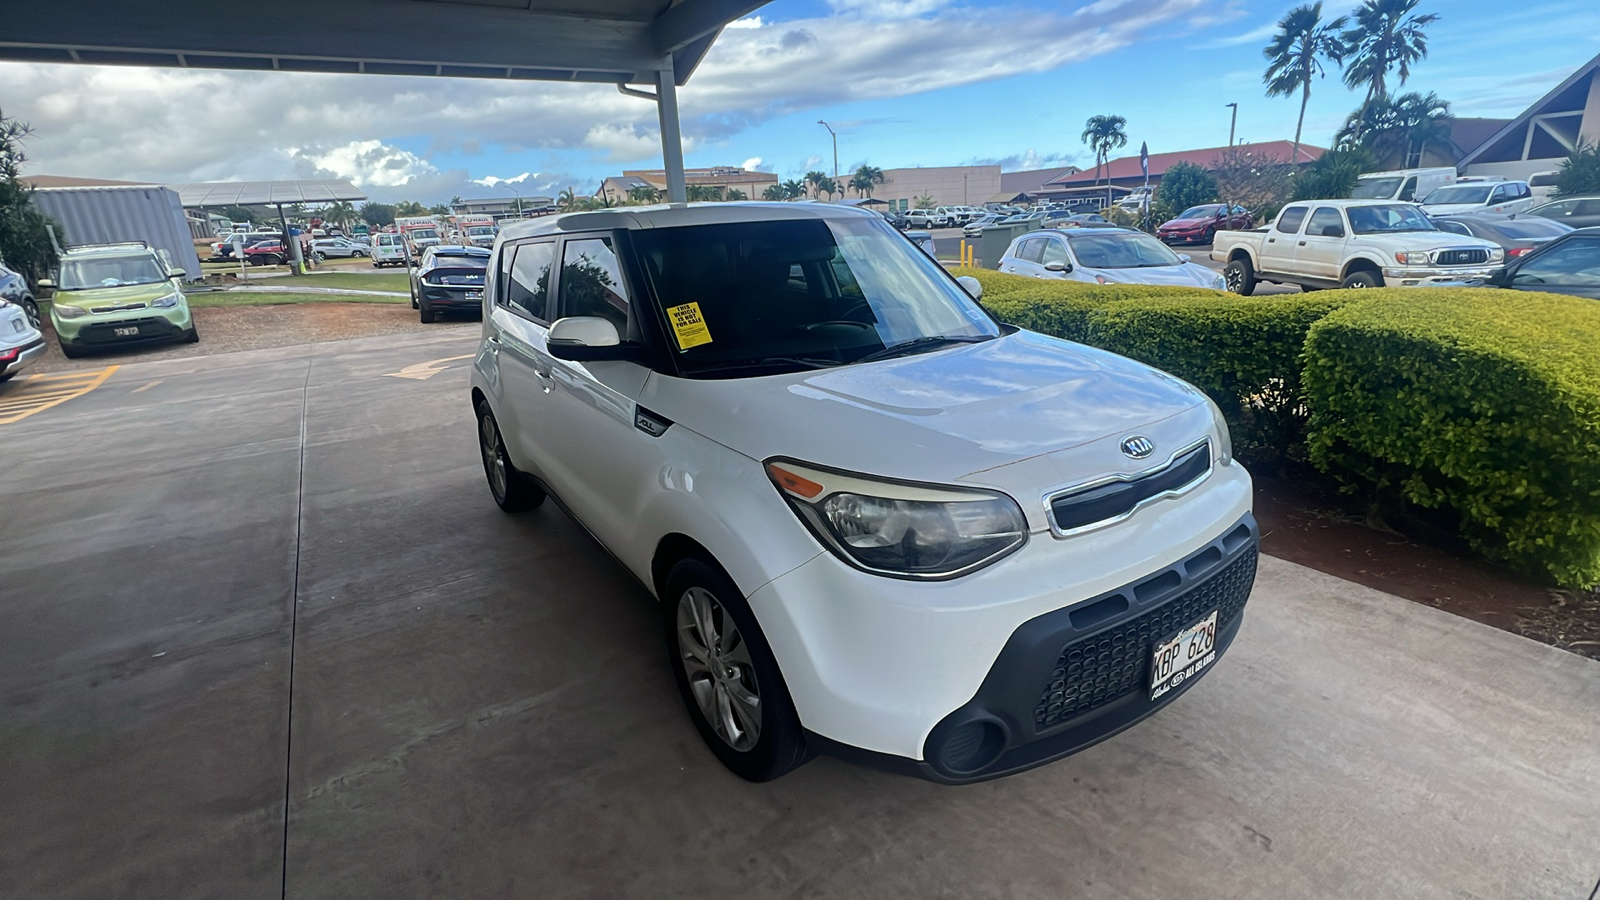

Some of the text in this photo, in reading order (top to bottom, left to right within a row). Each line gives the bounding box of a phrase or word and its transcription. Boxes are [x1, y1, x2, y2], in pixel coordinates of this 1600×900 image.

[673, 308, 697, 318] VEHICLE
[677, 304, 690, 312] THIS
[687, 317, 702, 325] SALE
[1125, 437, 1153, 455] KIA
[1152, 642, 1181, 681] KBP
[1187, 621, 1214, 660] 628
